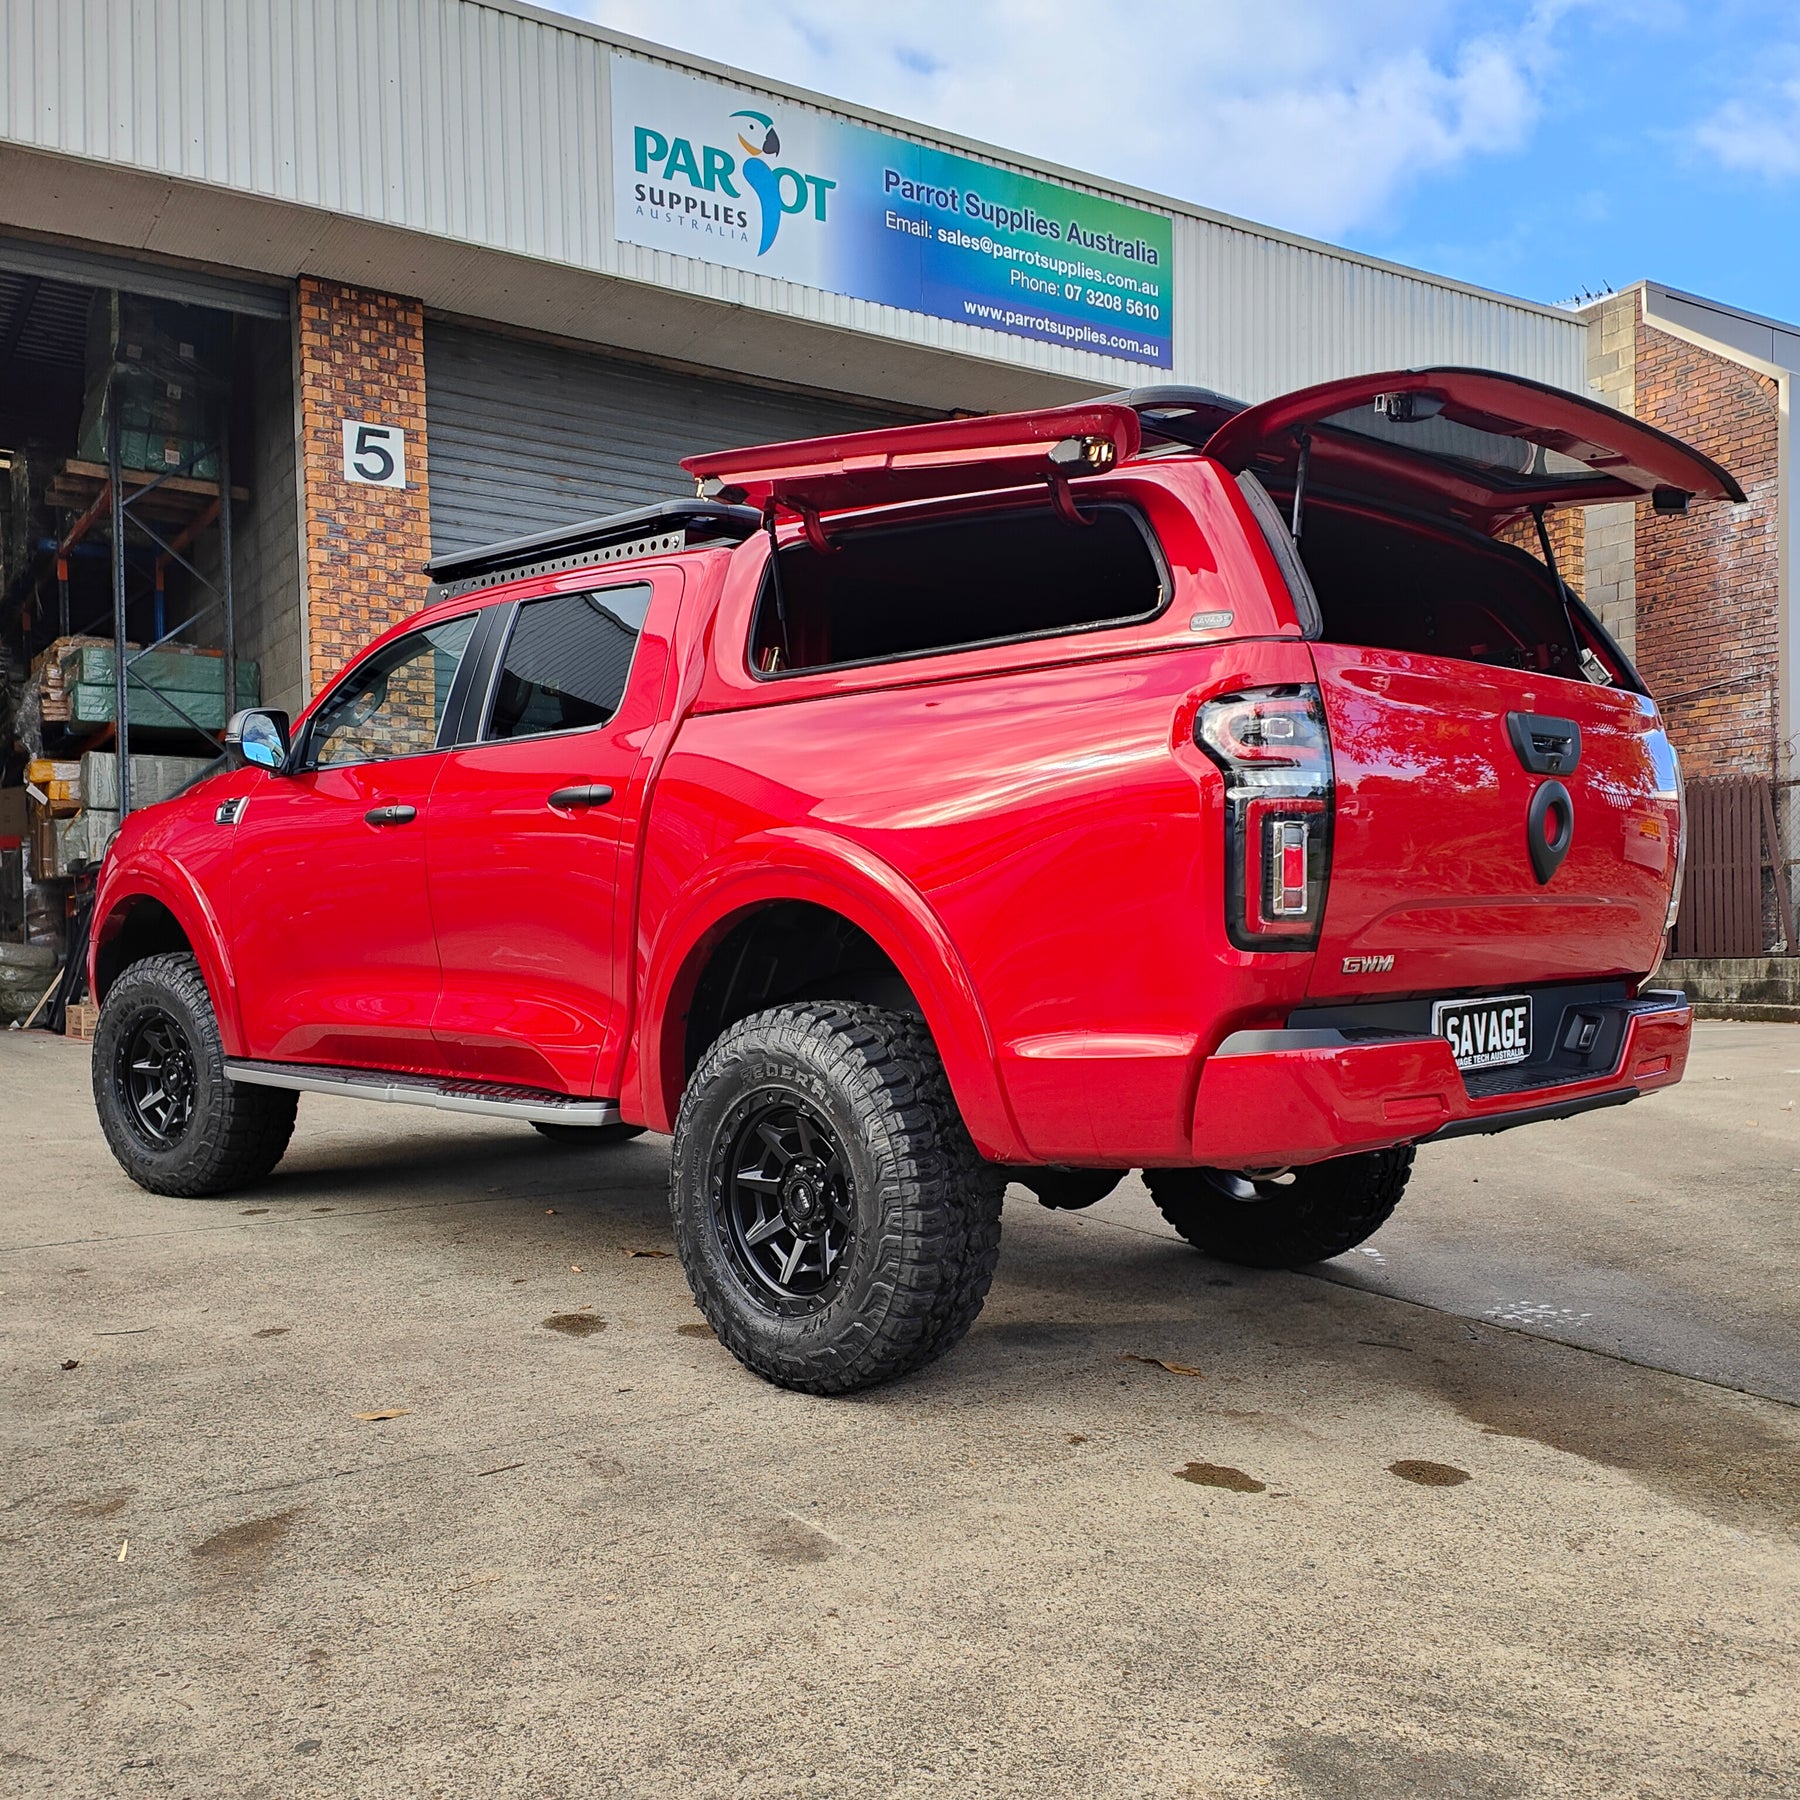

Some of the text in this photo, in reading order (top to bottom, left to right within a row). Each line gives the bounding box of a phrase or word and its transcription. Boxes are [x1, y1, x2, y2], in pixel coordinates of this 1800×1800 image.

[634, 184, 748, 228] SUPPLIES
[635, 204, 749, 243] AUSTRALIA
[884, 169, 1159, 266] Parrot Supplies Australia
[885, 210, 1159, 298] Email: sales@parrotsupplies.com.au
[1010, 269, 1160, 322] Phone: 07 3208 5610
[963, 300, 1159, 358] www.parrotsupplies.com.au
[353, 426, 394, 482] 5
[1342, 954, 1395, 974] GWM
[1446, 1006, 1527, 1058] SAVAGE
[1473, 1052, 1490, 1063] TECH
[1490, 1047, 1524, 1061] AUSTRALIA
[741, 1062, 835, 1115] FEDERAL
